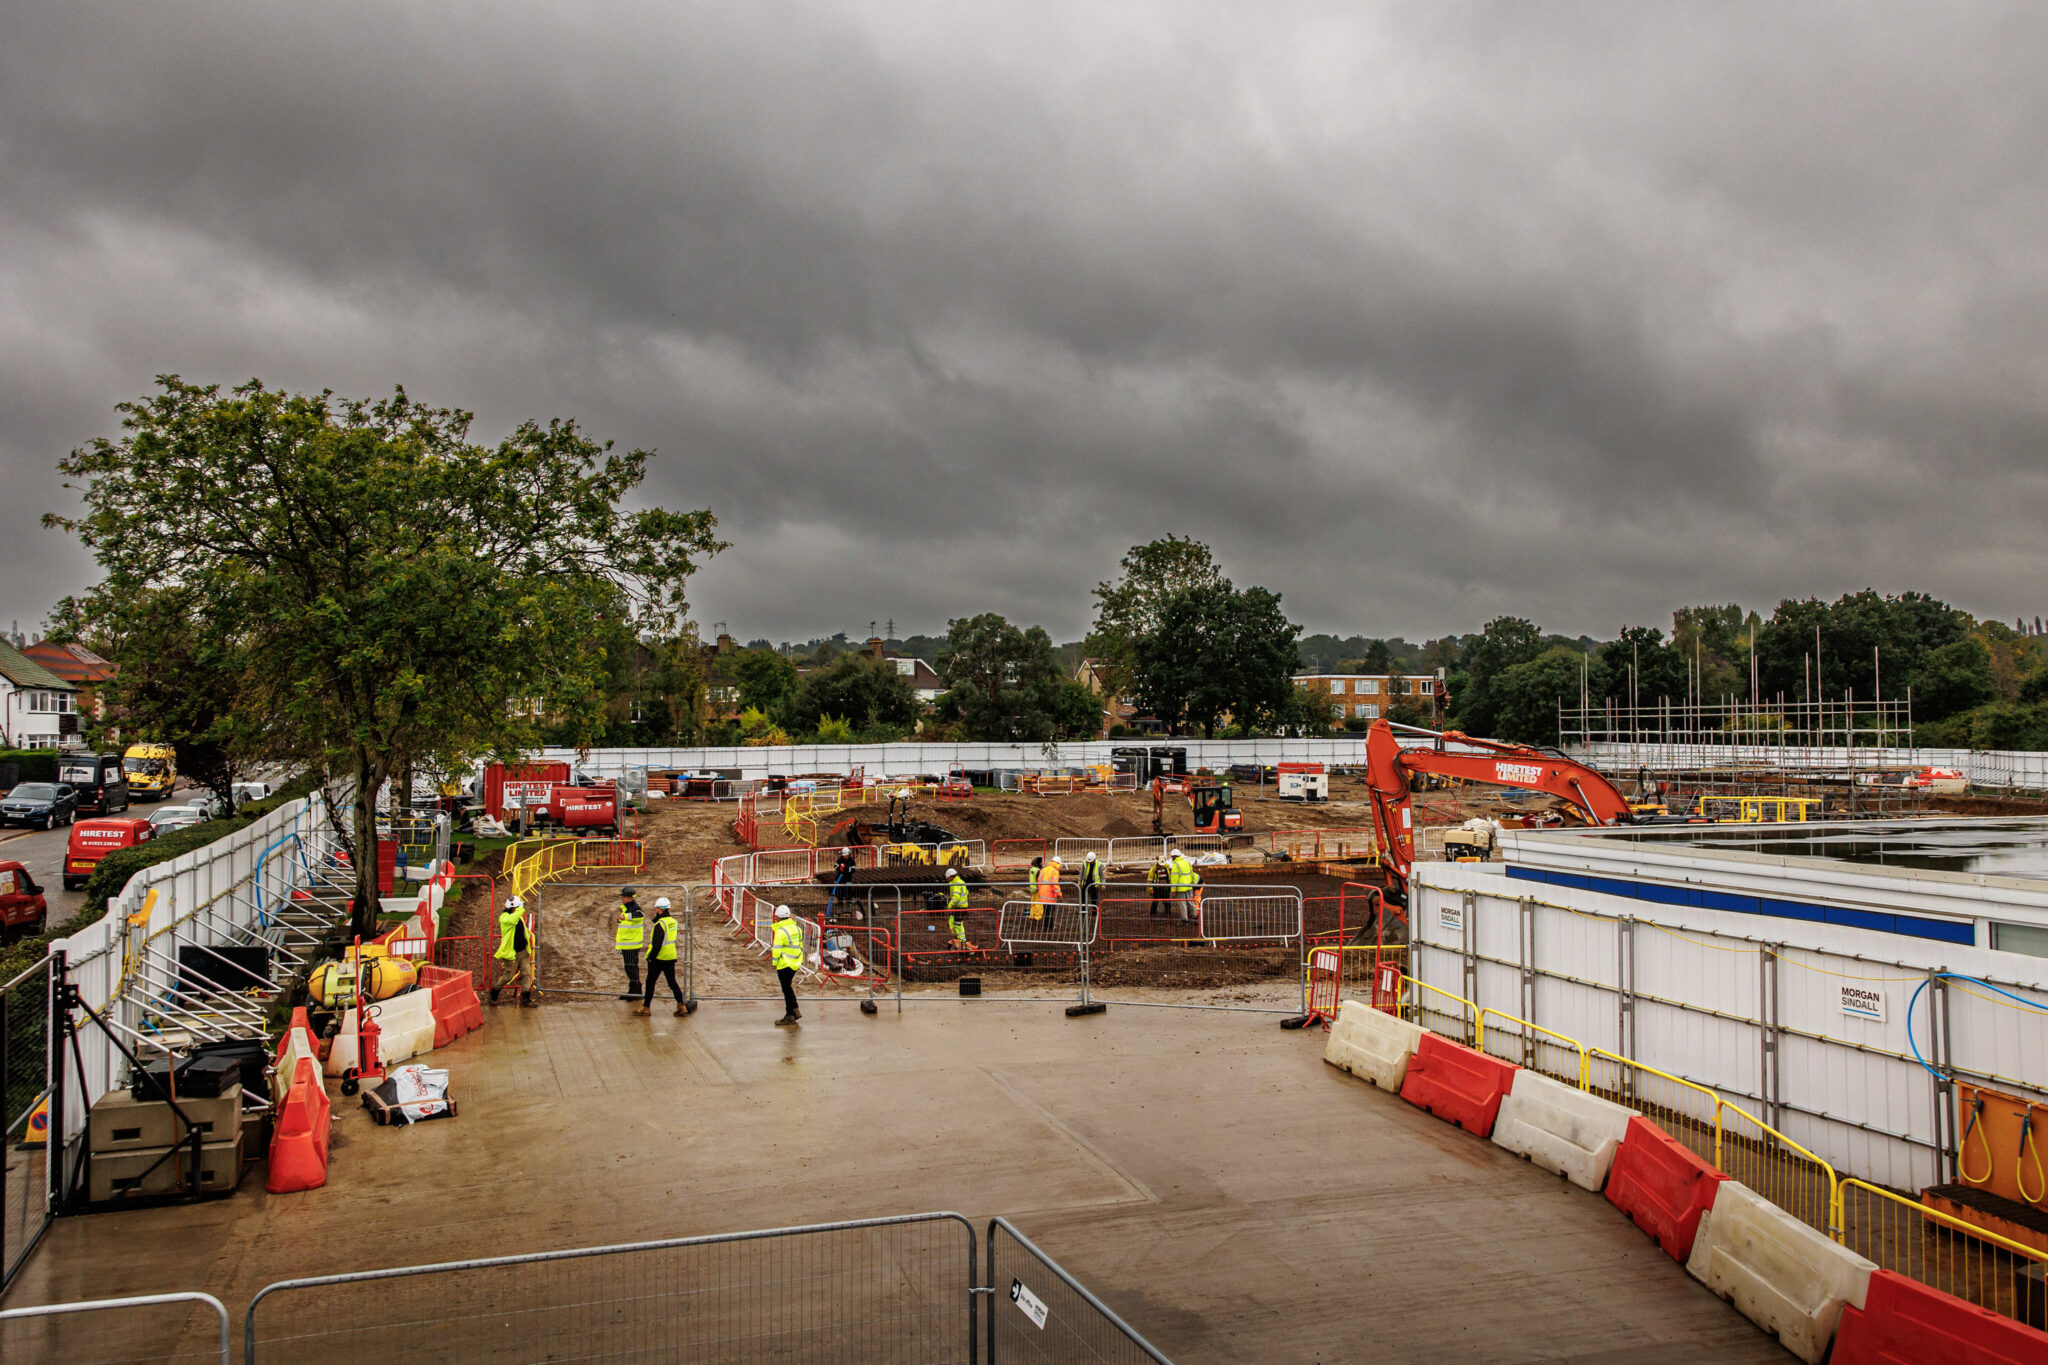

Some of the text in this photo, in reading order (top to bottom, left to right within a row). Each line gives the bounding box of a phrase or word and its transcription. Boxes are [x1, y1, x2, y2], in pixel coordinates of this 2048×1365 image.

[1496, 762, 1542, 776] HIRETEST
[1497, 770, 1537, 784] LIMITED
[80, 830, 125, 838] HIRETEST
[1441, 907, 1460, 917] MORGAN
[1441, 914, 1459, 923] SINDALL
[1841, 987, 1880, 1002] MORGAN
[1841, 997, 1878, 1011] SINDALL
